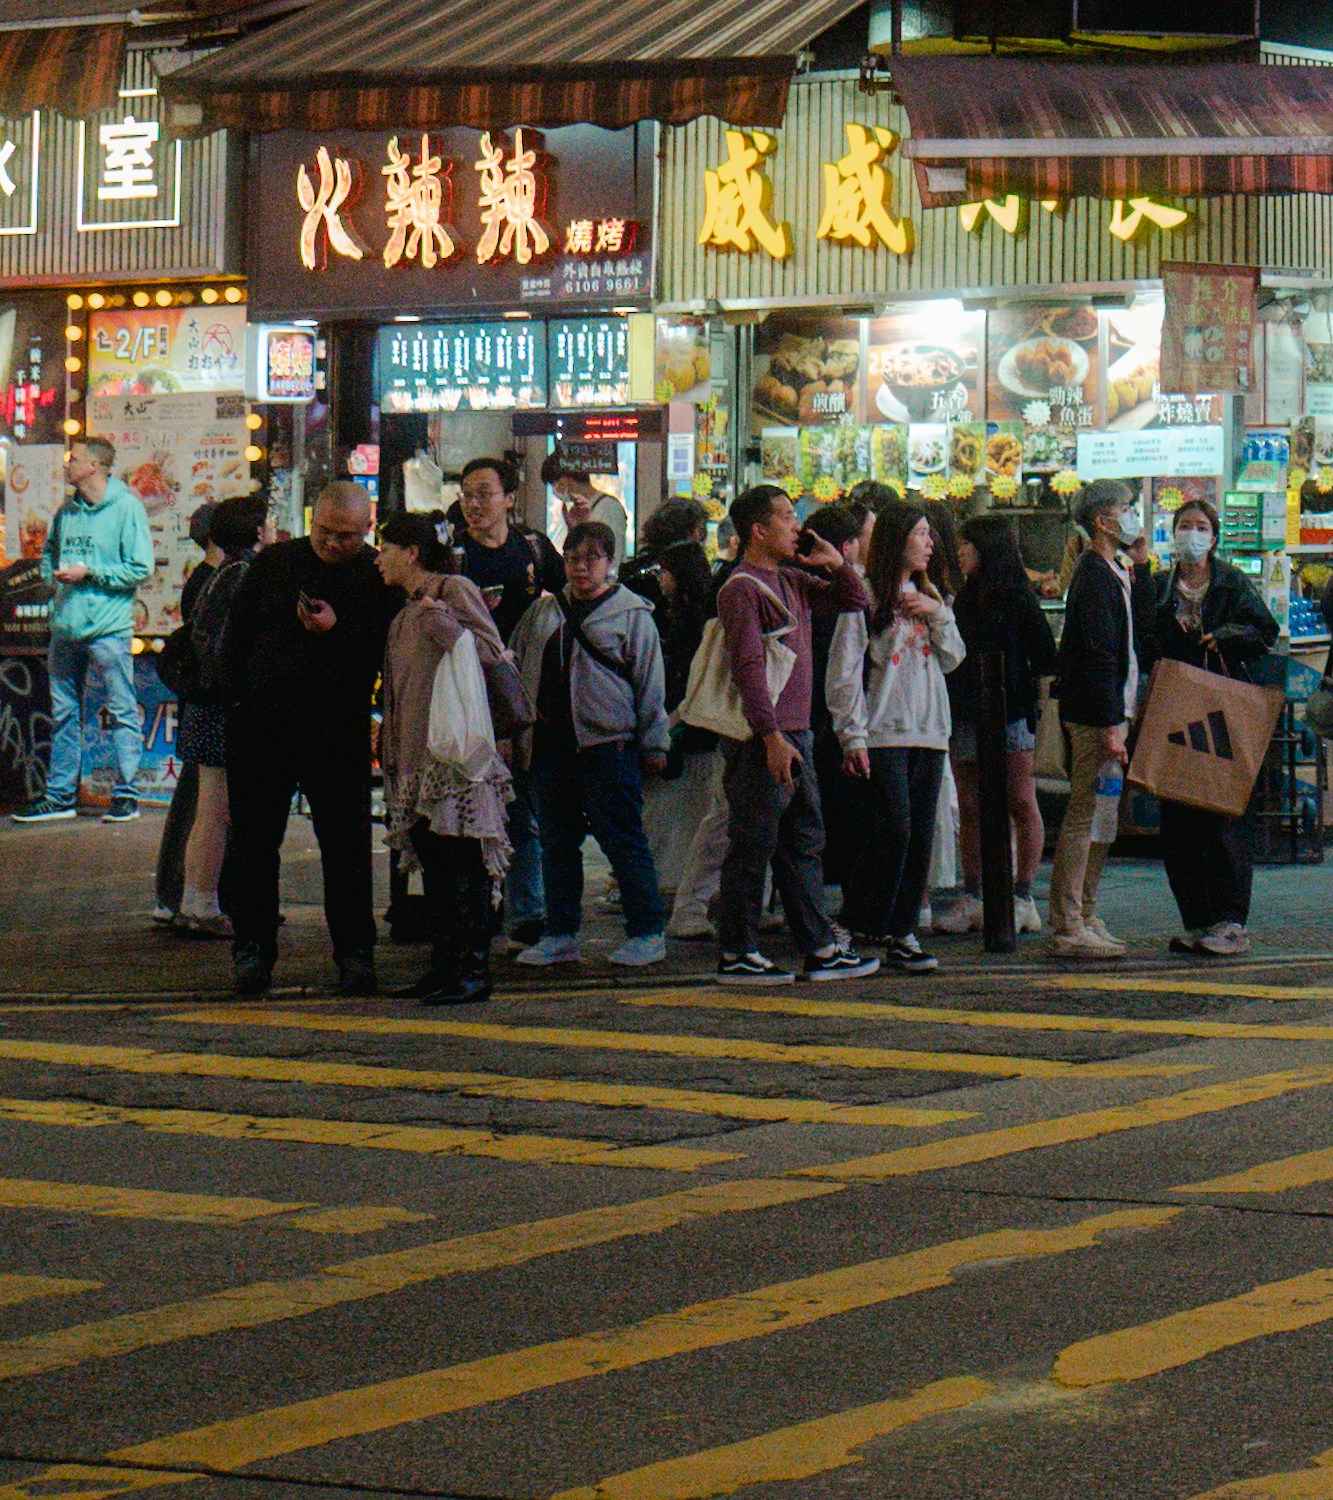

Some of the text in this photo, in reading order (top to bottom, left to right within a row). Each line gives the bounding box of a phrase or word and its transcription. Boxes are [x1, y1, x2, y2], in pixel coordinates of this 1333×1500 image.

[298, 128, 549, 270] 火辣辣
[564, 218, 626, 254] 燒烤
[564, 277, 641, 294] 6106 9661
[115, 326, 157, 363] 2/F
[930, 391, 965, 411] 五香
[1060, 405, 1094, 426] 魚蛋
